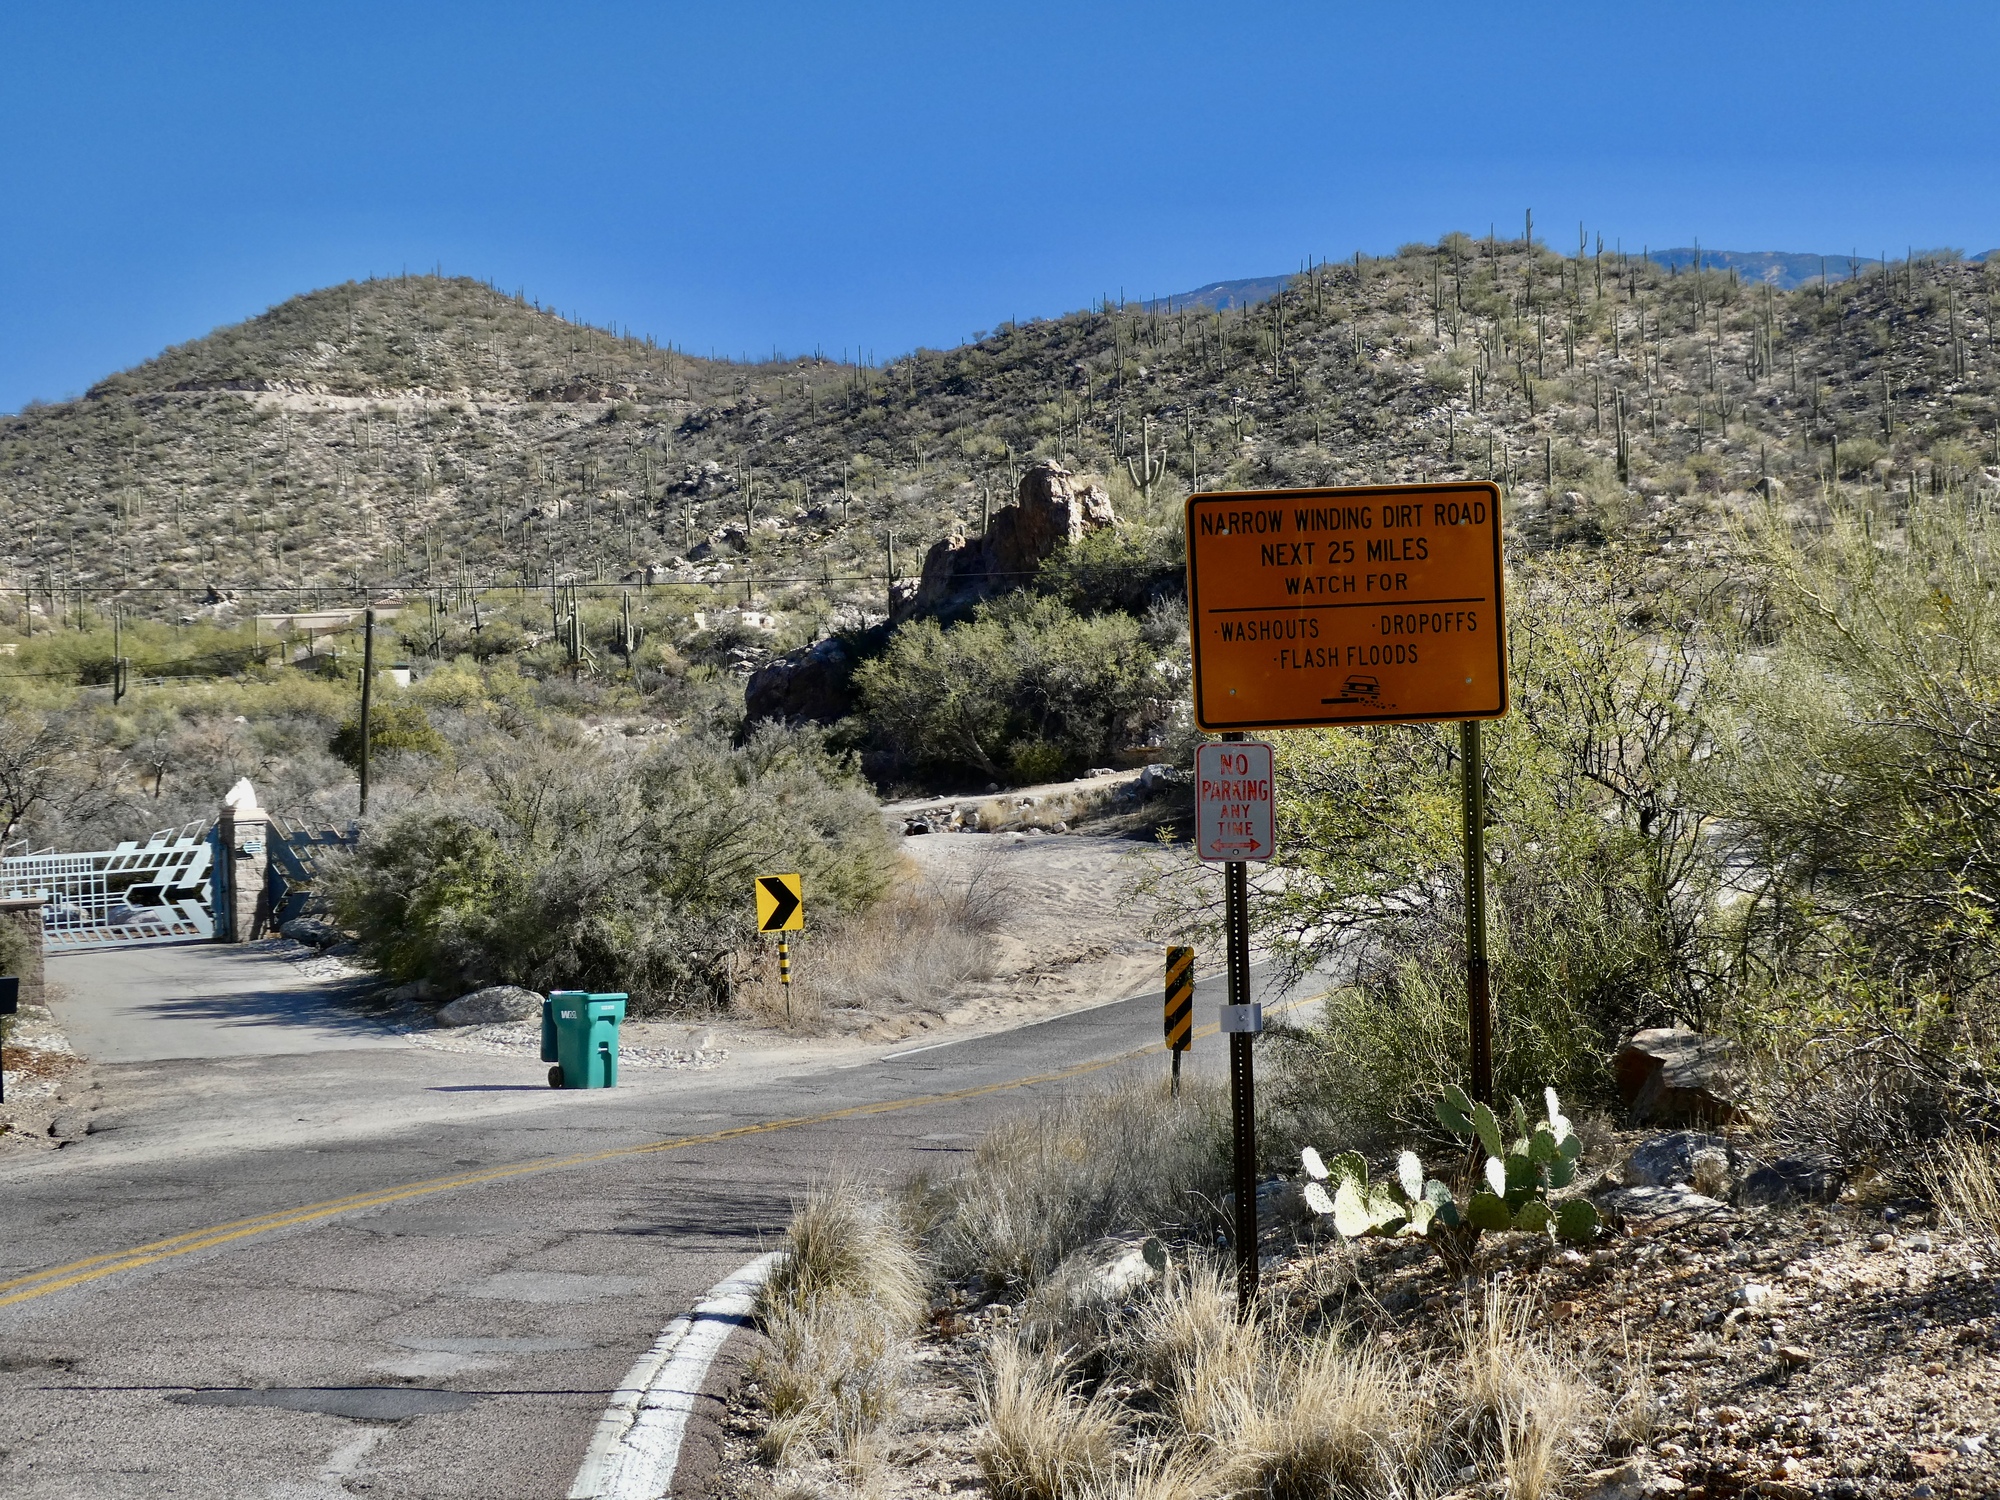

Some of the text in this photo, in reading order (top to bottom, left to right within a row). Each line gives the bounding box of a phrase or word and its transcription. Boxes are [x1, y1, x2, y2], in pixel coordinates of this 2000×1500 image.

[1201, 502, 1485, 536] NARROW WINDING DIRT ROAD
[1261, 537, 1429, 566] NEXT 25 MILES
[1285, 573, 1408, 595] WATCH FOR
[1221, 618, 1319, 642] WASHOUTS
[1381, 612, 1477, 635] DROPOFFS
[1281, 644, 1417, 669] FLASH FLOODS
[1221, 754, 1248, 775] NO
[1202, 780, 1268, 801] PARKING
[1221, 804, 1250, 818] ANY
[1218, 822, 1253, 836] TIME
